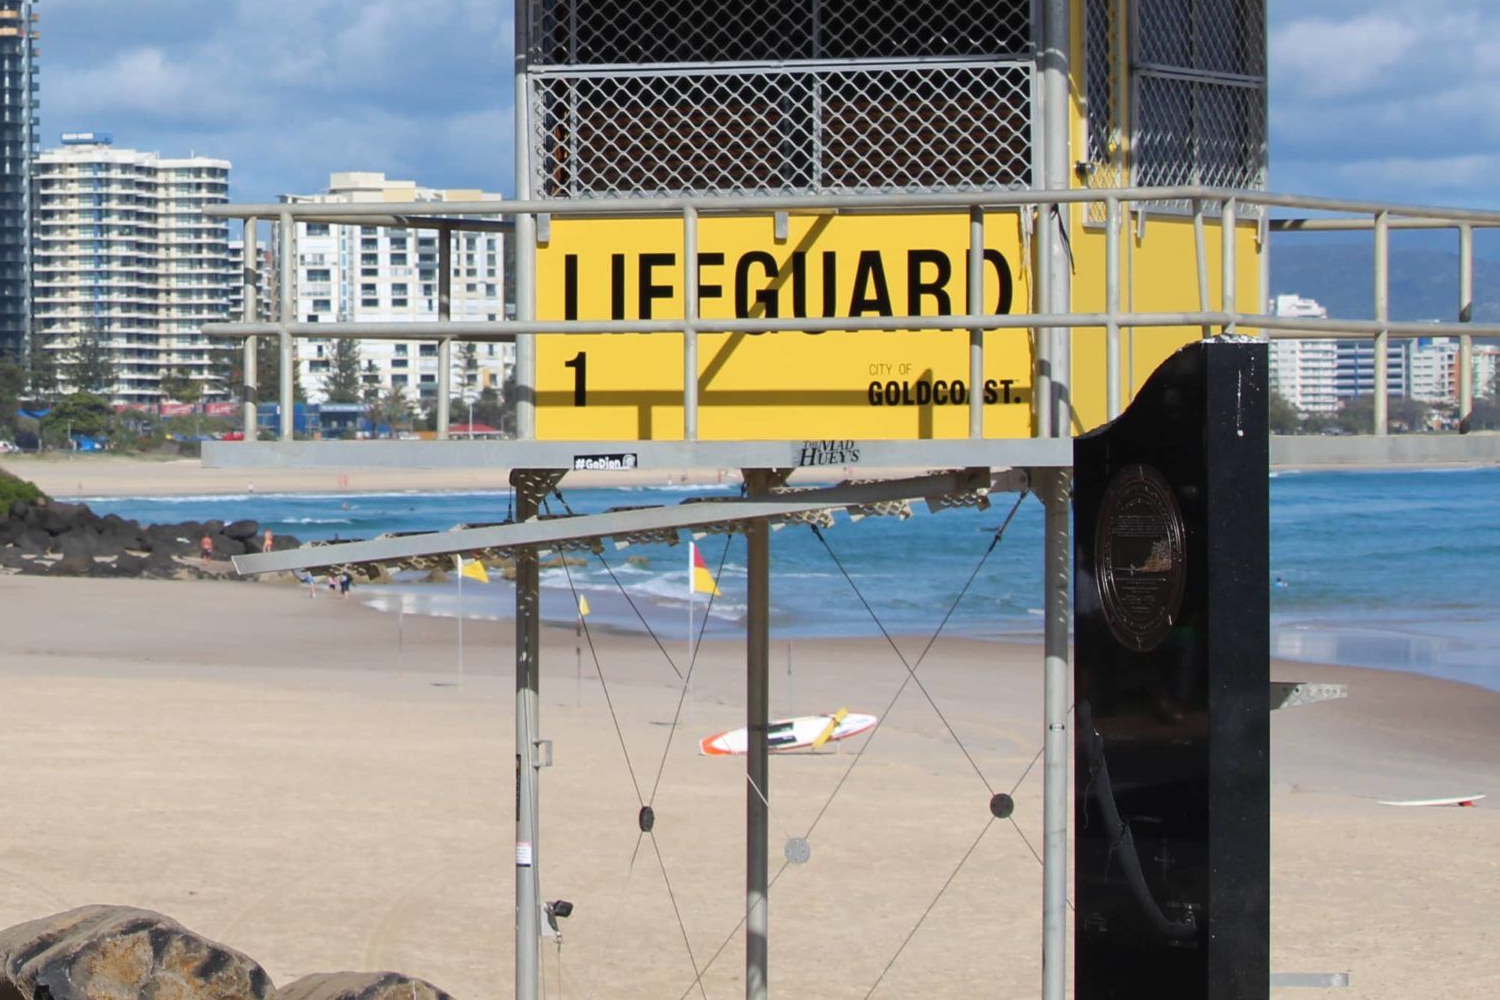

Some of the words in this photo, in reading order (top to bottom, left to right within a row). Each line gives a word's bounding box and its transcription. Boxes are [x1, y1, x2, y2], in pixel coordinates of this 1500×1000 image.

[869, 364, 892, 376] CITY
[899, 363, 913, 375] OF
[565, 352, 586, 407] 1
[868, 379, 1021, 406] GOLDCOST.
[820, 439, 854, 451] MAD
[800, 448, 860, 467] HUEY'S
